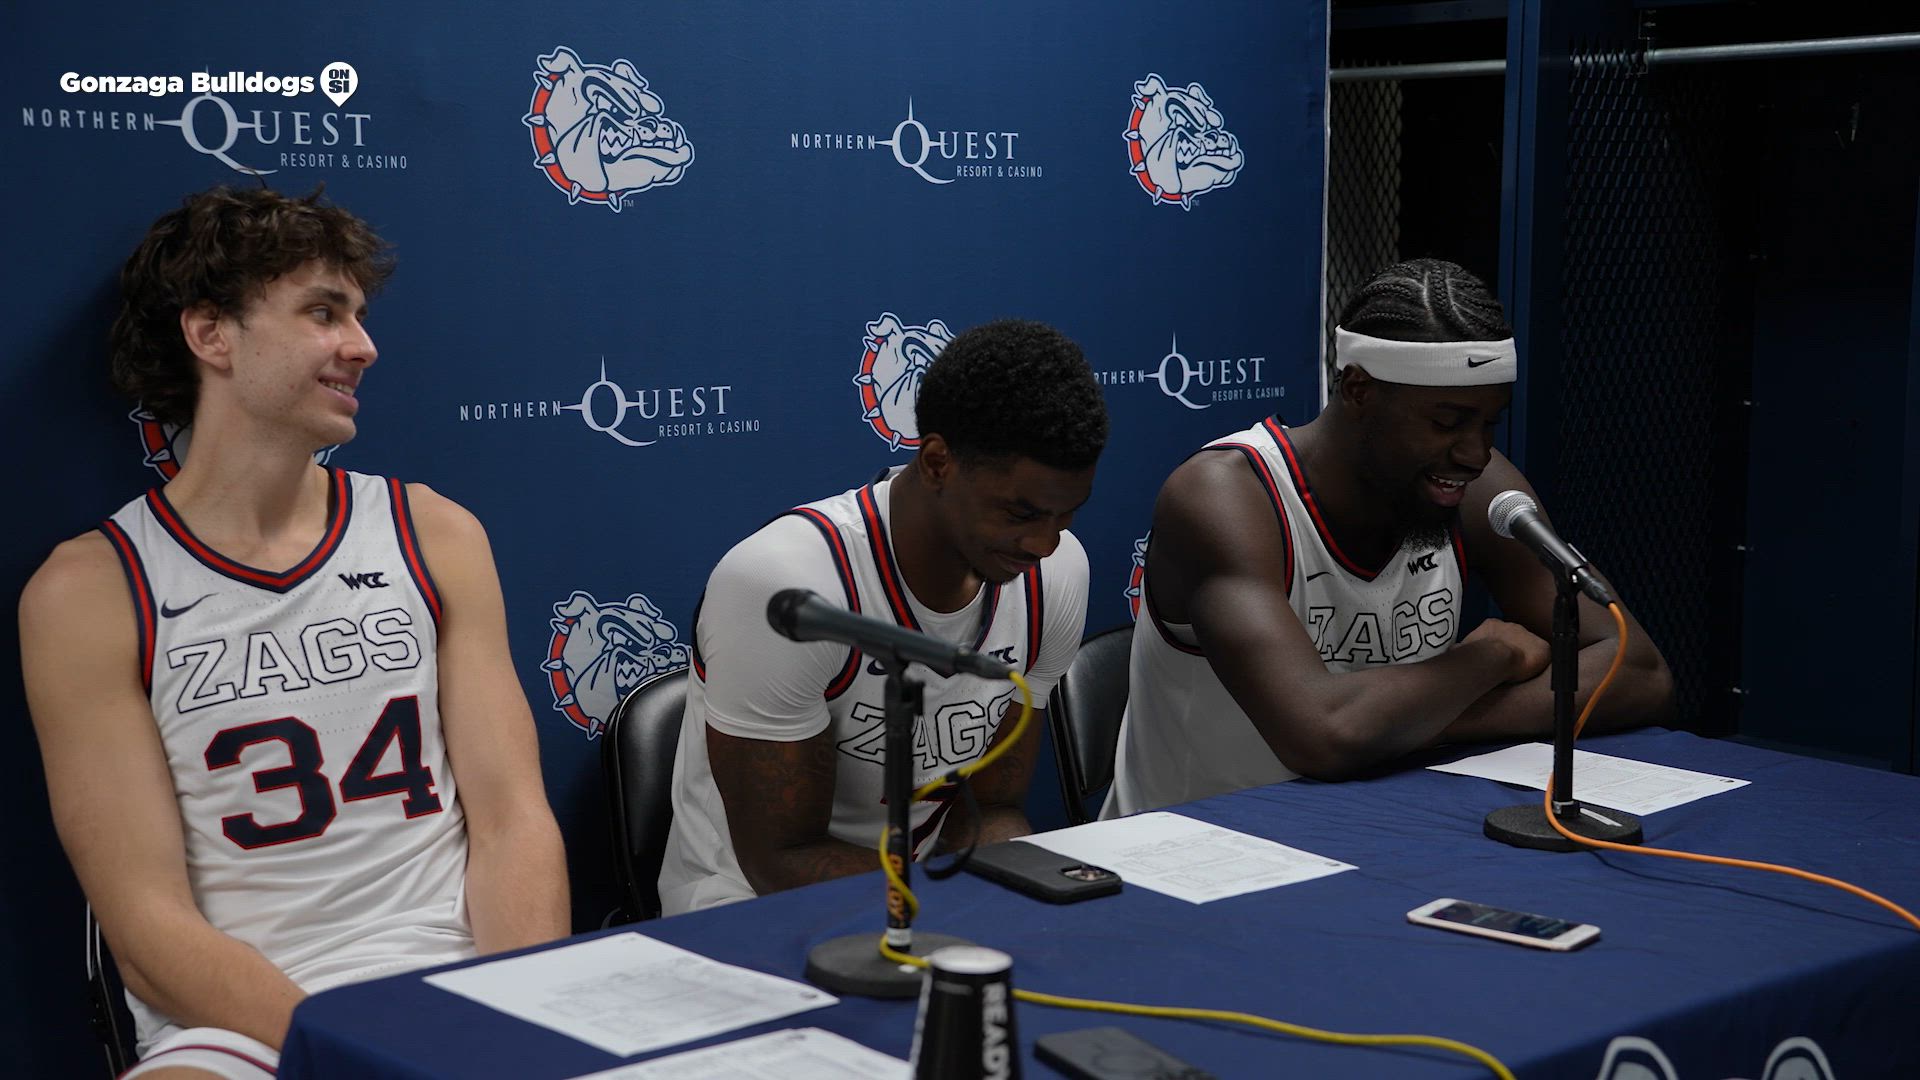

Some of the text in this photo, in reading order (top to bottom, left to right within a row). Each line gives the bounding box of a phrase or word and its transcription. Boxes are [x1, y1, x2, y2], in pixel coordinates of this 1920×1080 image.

[22, 94, 371, 175] NORTHERN QUEST
[281, 153, 408, 169] RESORT & CASINO
[791, 118, 1019, 184] NORTHERN QUEST
[957, 165, 1043, 178] RESORT & CASINO
[1093, 353, 1265, 409] RTHERN QUEST
[1212, 387, 1285, 401] RESORT & CASINO
[460, 380, 732, 447] NORTHERN QUEST
[659, 420, 760, 437] RESORT & CASINO
[167, 608, 422, 714] ZAGS
[204, 695, 443, 850] 34
